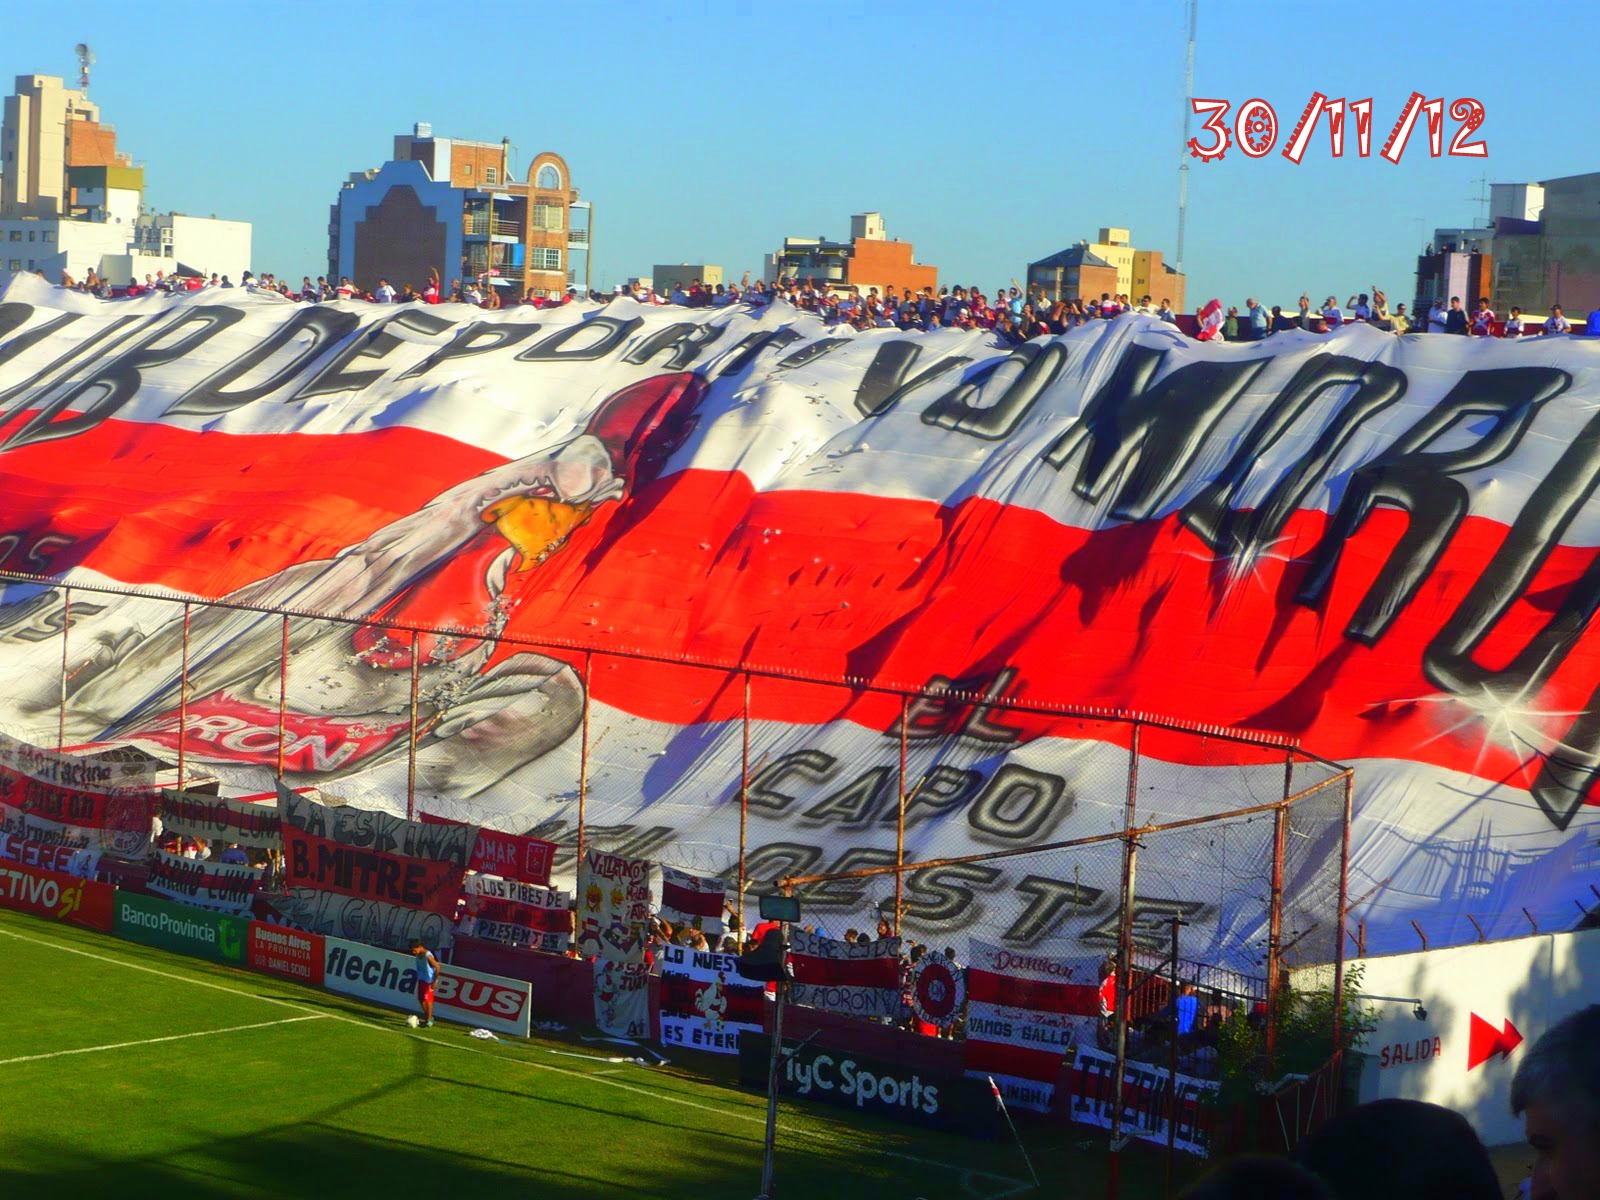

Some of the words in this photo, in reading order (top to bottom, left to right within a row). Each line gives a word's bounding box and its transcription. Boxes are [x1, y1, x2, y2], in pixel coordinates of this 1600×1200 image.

[883, 664, 1024, 743] EL
[735, 748, 1066, 839] CAPO
[286, 795, 326, 838] LA
[335, 806, 468, 868] ESKINA
[0, 869, 59, 908] TIVO
[509, 882, 543, 907] PIBES
[724, 842, 1205, 949] OESTE
[255, 927, 287, 947] Buenos
[288, 933, 312, 951] Aires
[342, 897, 444, 949] GALLO
[268, 943, 311, 961] PROVINCIA
[326, 947, 418, 994] flecha
[664, 946, 684, 965] LO
[436, 976, 524, 1015] BUS
[664, 1024, 683, 1043] ES
[692, 1027, 740, 1050] ETER
[970, 1016, 1012, 1038] VAMOS
[1021, 1026, 1072, 1048] GALLO
[1381, 1036, 1442, 1068] SALIDA
[780, 1046, 835, 1094] TyC
[839, 1060, 939, 1115] Sports
